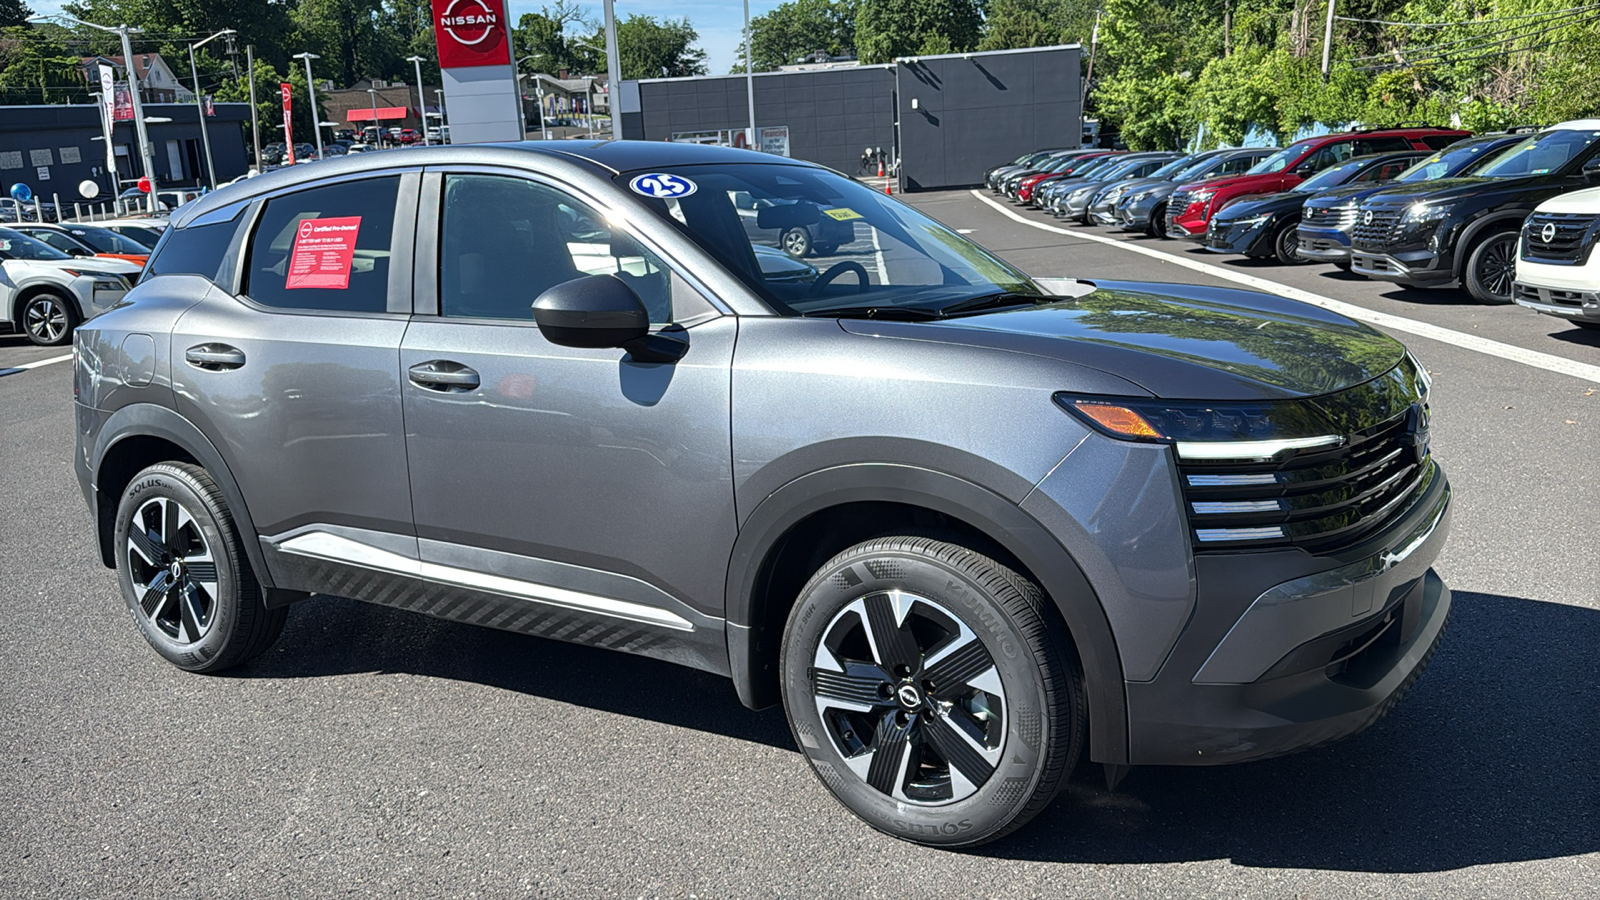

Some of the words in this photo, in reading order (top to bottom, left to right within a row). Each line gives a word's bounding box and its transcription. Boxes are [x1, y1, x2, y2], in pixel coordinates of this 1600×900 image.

[441, 14, 496, 26] NISSAN
[642, 174, 685, 197] 25
[129, 479, 162, 499] SOLUS
[802, 602, 816, 625] 96H
[944, 580, 1017, 660] KUMHO
[893, 818, 974, 837] SOLUS
